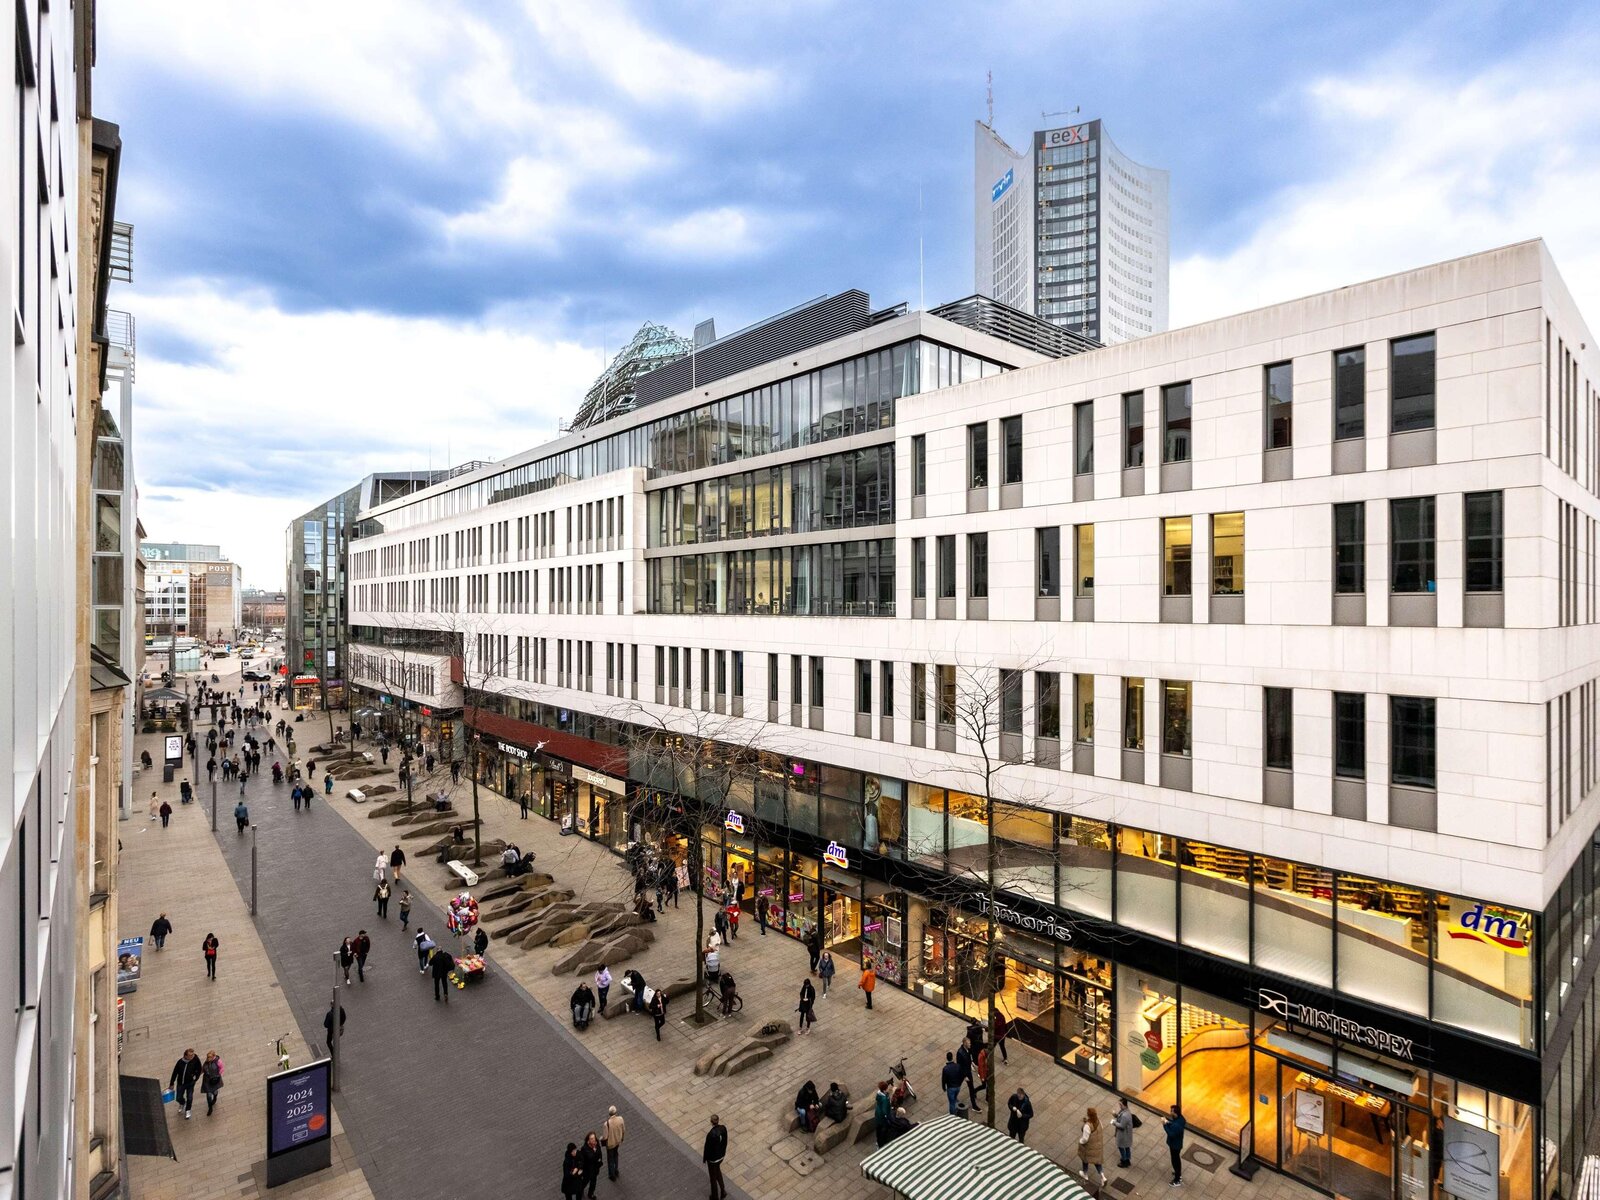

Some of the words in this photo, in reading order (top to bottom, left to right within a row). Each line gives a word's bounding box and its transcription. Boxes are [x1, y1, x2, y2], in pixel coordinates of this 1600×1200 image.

[497, 741, 506, 752] THE
[505, 744, 517, 755] BODY
[516, 747, 528, 759] SHOP
[728, 811, 742, 825] dm
[828, 842, 846, 859] dm
[1461, 904, 1518, 939] dm
[1298, 1003, 1361, 1043] MISTER
[1364, 1026, 1414, 1061] SPEX
[286, 1087, 313, 1104] 2024
[286, 1102, 314, 1119] 2025
